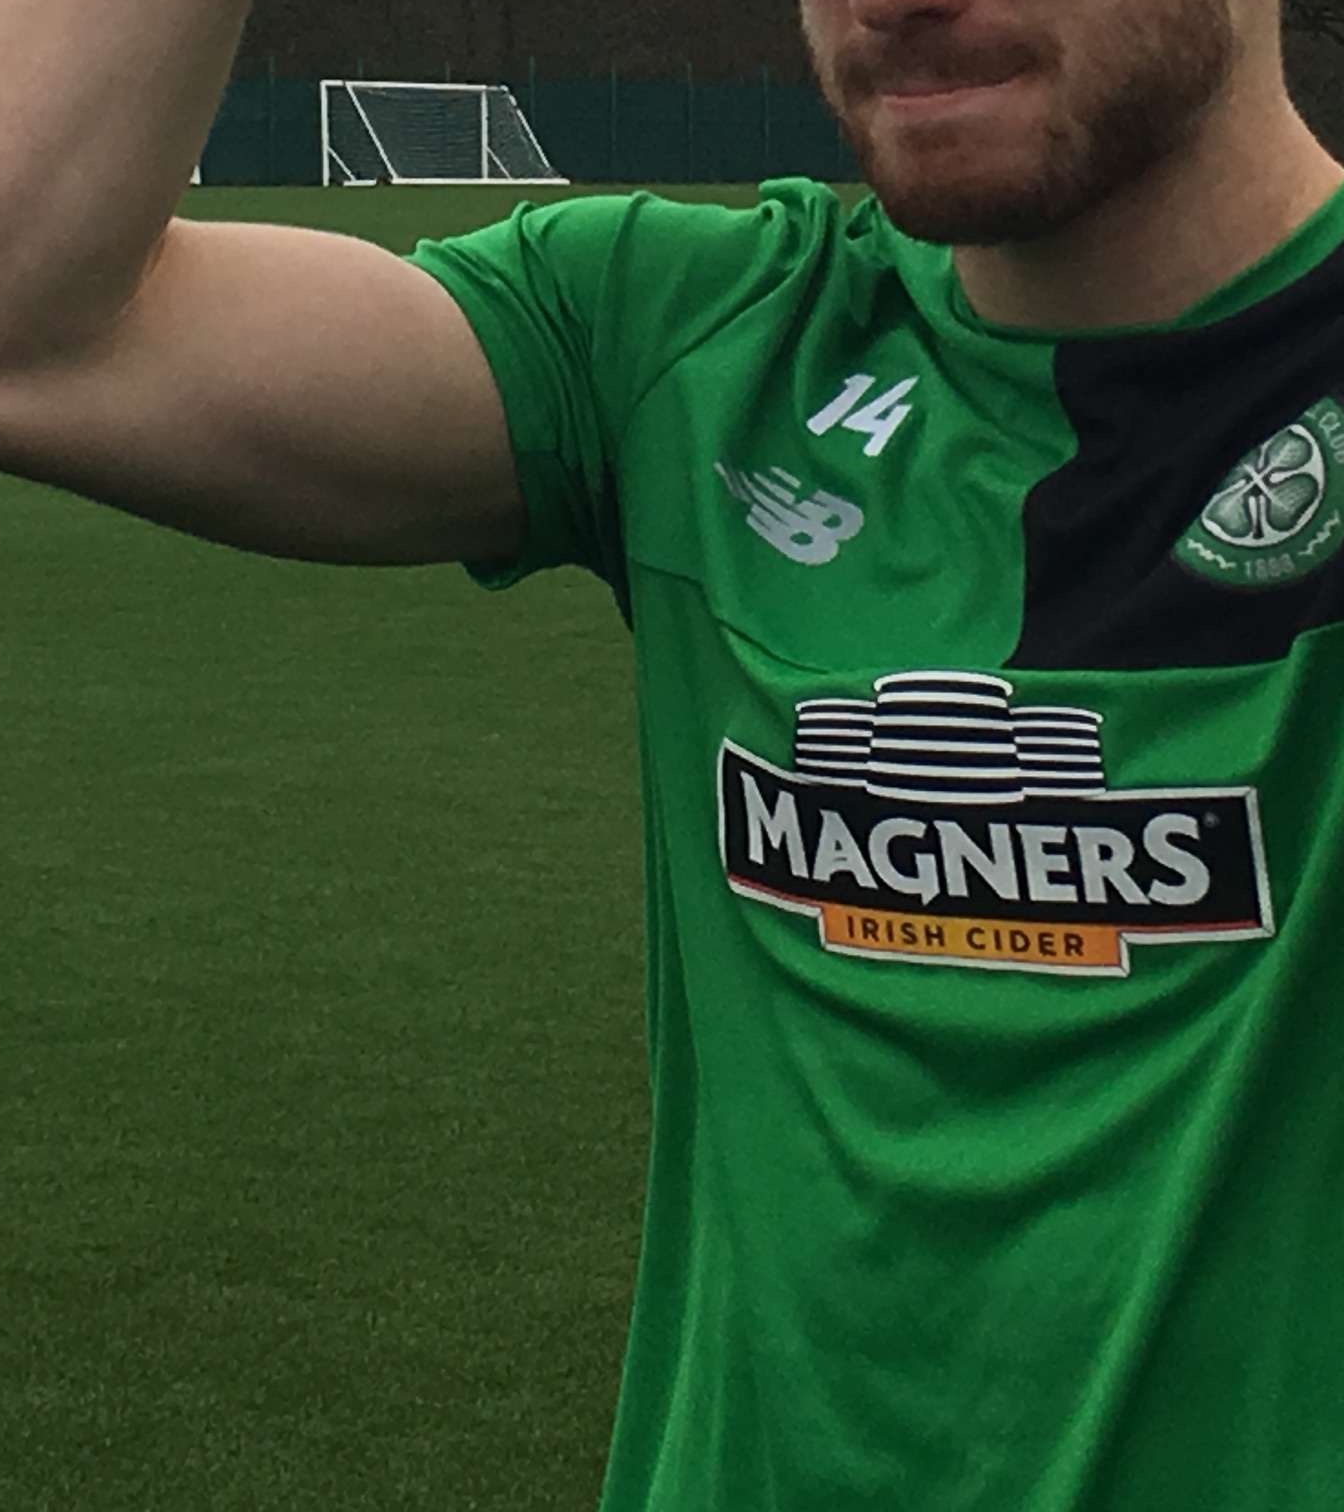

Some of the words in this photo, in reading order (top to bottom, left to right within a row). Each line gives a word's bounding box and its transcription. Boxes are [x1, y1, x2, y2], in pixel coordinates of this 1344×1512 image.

[807, 374, 920, 457] 14
[739, 771, 1211, 906] MAGNERS
[846, 915, 945, 948] IRISH
[966, 926, 1085, 957] CIDER
